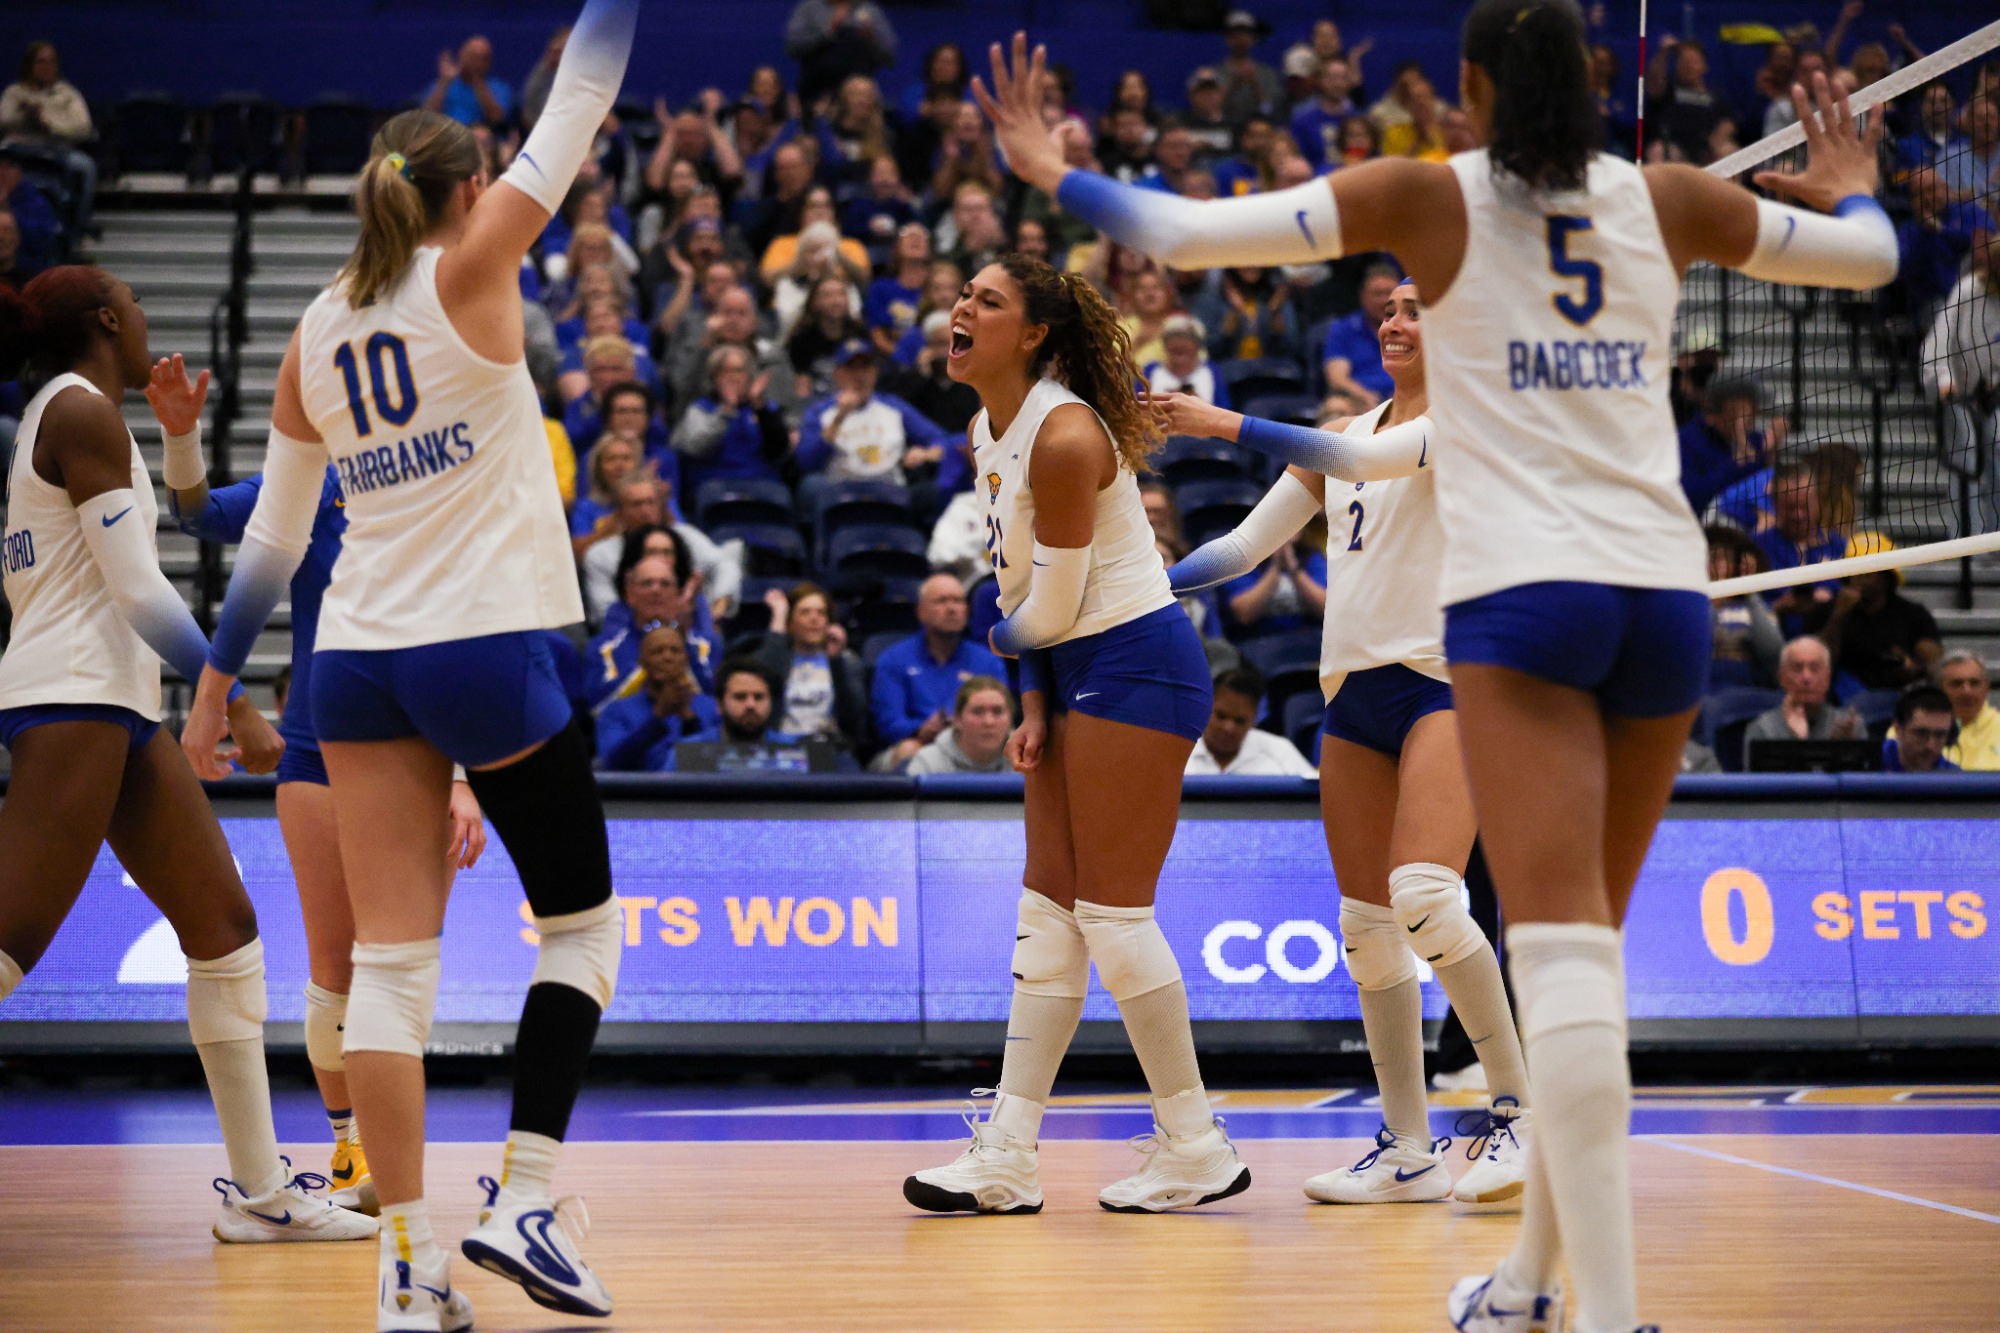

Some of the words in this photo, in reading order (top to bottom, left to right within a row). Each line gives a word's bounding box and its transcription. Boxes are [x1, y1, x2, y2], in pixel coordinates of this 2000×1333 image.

[1546, 214, 1605, 327] 5
[334, 330, 419, 439] 10
[1508, 340, 1649, 390] BABCOCK
[338, 422, 474, 497] FAIRBANKS
[987, 513, 1010, 569] 21
[1347, 500, 1364, 551] 2
[725, 897, 898, 946] WON
[1701, 867, 1774, 965] 0
[1811, 890, 1987, 940] SETS
